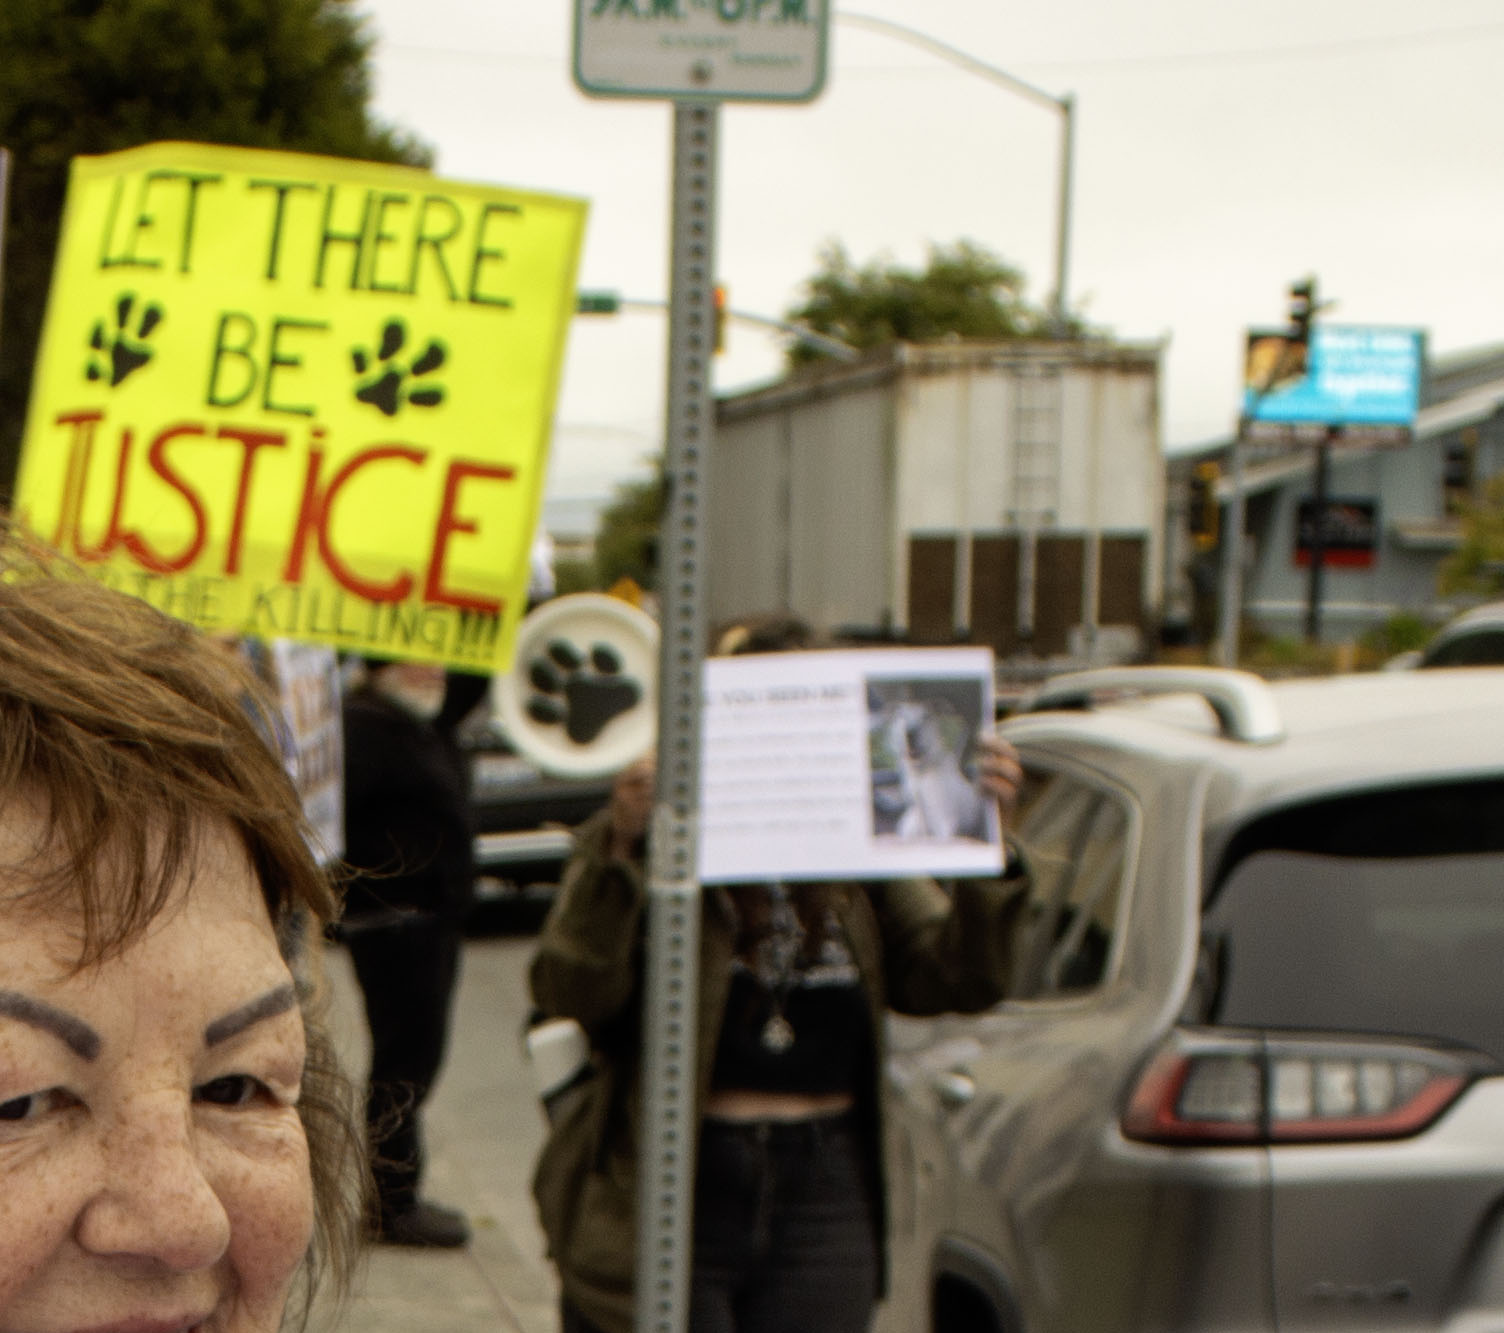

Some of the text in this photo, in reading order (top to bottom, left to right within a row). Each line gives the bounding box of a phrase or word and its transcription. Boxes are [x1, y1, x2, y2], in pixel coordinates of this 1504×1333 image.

[98, 170, 523, 309] LET THERE
[205, 311, 331, 416] BE
[50, 409, 517, 612] JUSTICE
